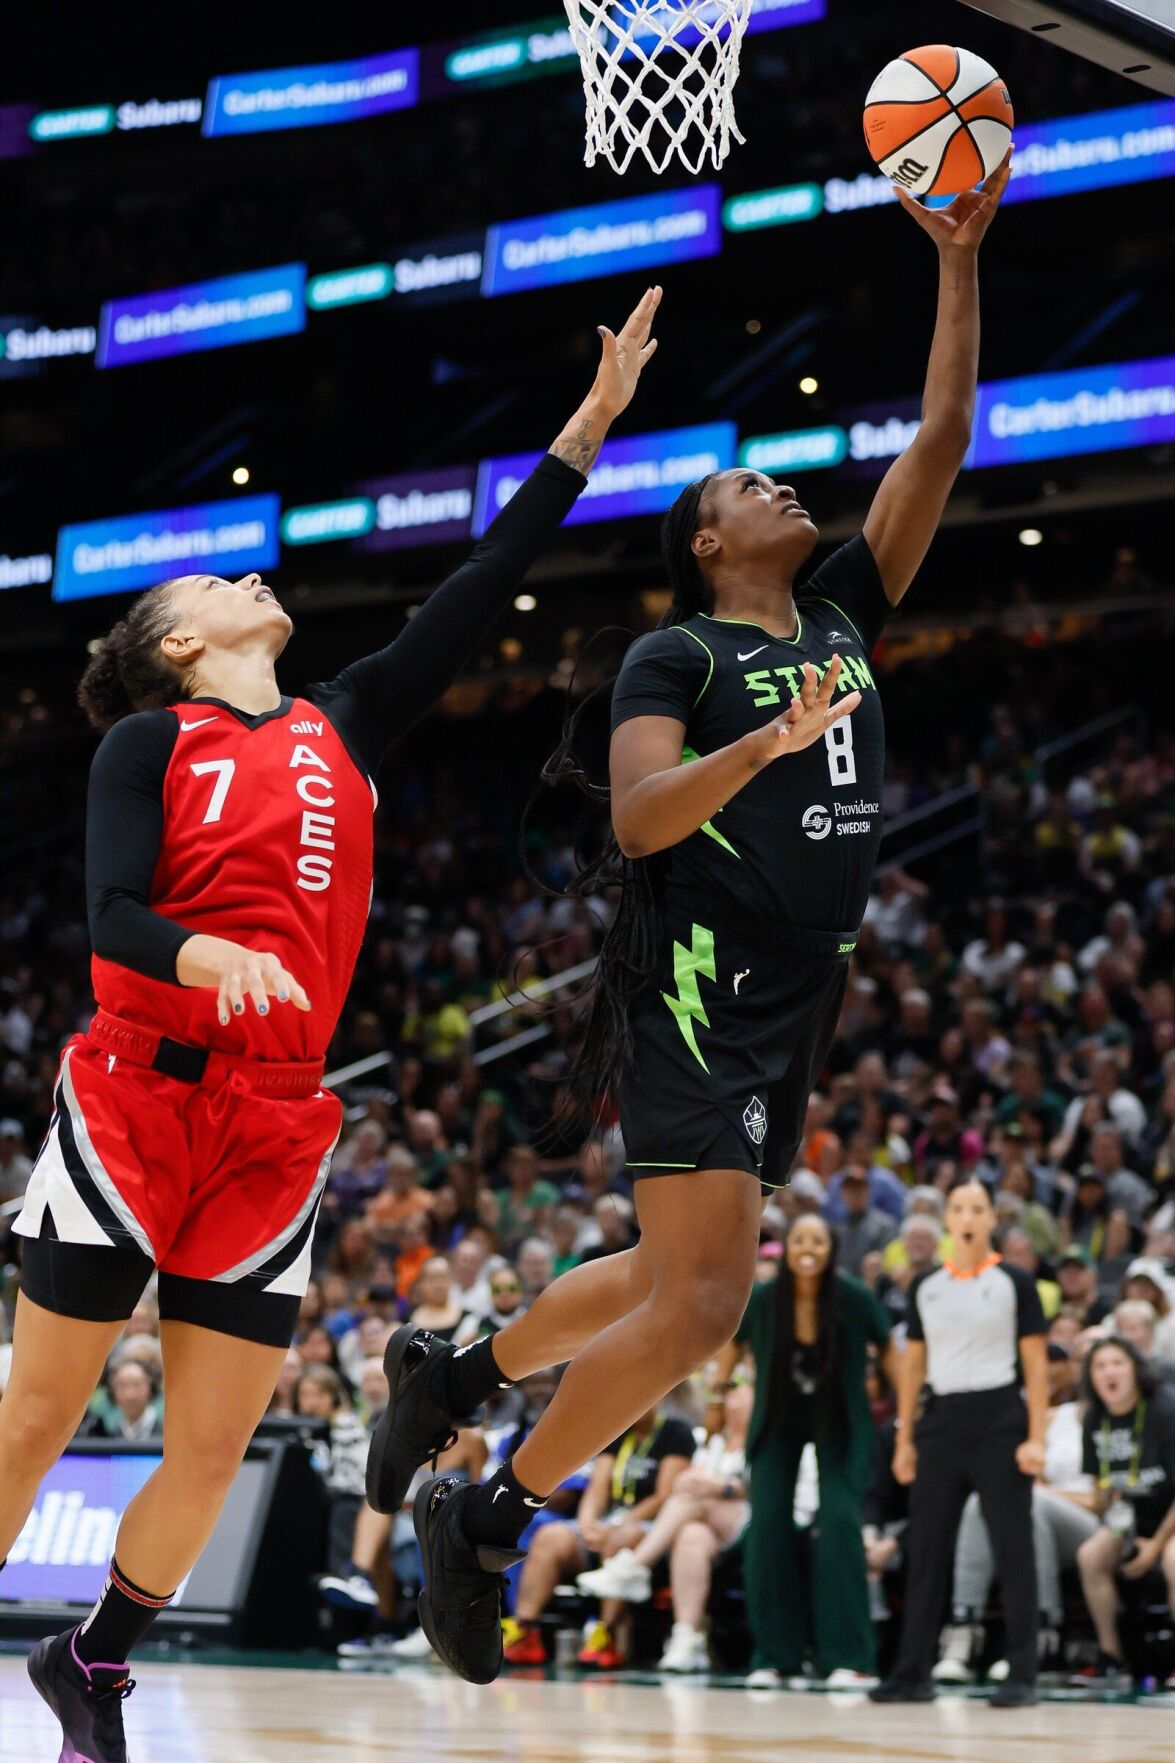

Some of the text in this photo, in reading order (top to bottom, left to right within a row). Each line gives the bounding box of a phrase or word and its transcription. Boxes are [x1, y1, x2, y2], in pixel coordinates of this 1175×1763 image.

[117, 98, 201, 130] Subaru
[824, 173, 897, 213] Suba
[395, 251, 481, 293] Subaru
[6, 326, 96, 361] Subaru
[989, 385, 1175, 438] CarterSubaru
[850, 417, 922, 460] Suba
[377, 488, 471, 531] Subaru
[0, 553, 52, 589] baru
[290, 720, 324, 737] ally
[824, 714, 857, 786] 8
[190, 758, 236, 825] 7
[833, 799, 880, 817] Providence
[289, 744, 336, 892] ACES
[836, 821, 871, 836] SWEDISH
